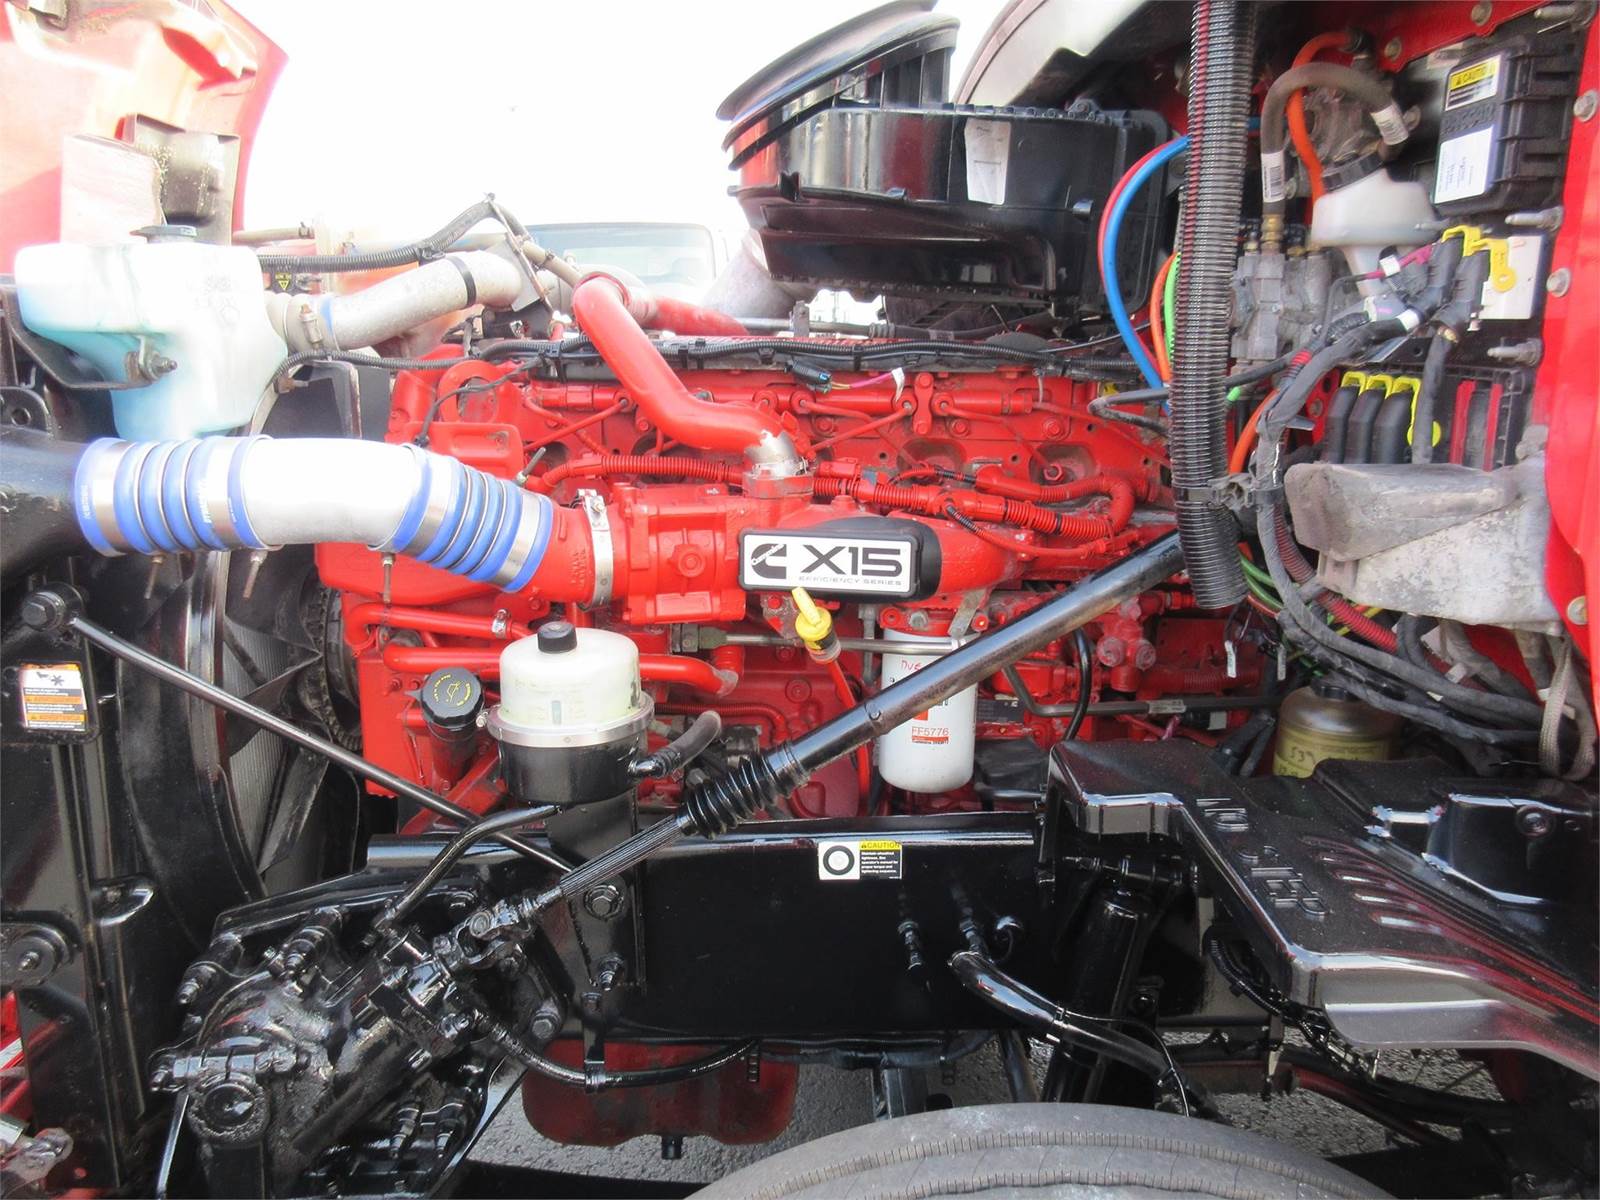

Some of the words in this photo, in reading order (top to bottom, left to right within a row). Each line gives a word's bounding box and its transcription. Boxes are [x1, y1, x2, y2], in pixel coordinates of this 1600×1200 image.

[801, 544, 902, 577] X15
[798, 575, 861, 584] EFFICIENCY
[863, 578, 902, 586] SERIES
[912, 726, 949, 737] FF5776
[1237, 844, 1329, 922] STEP
